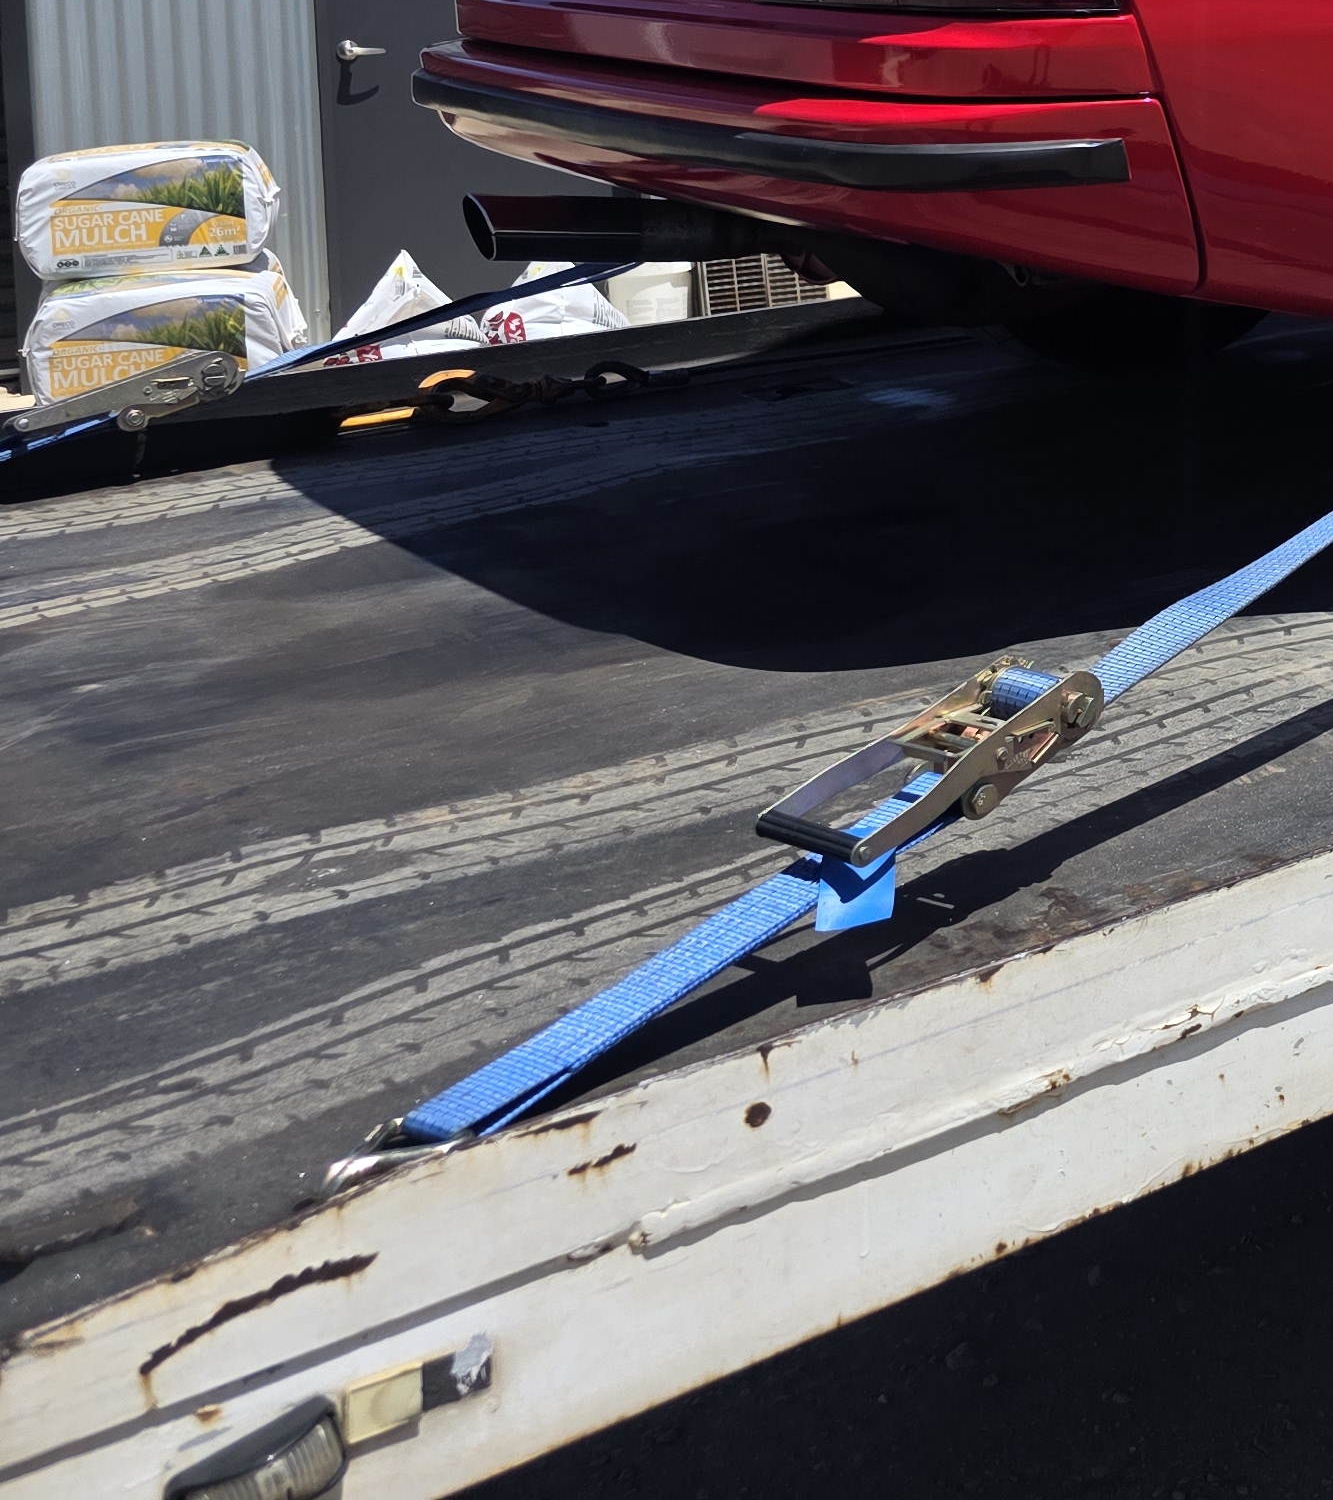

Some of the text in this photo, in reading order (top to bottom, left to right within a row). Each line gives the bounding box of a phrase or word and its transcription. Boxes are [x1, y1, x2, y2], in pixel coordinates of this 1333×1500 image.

[53, 208, 165, 230] SUGAR CANE
[55, 223, 147, 248] MULCH
[53, 348, 164, 371] SUGAR CANE
